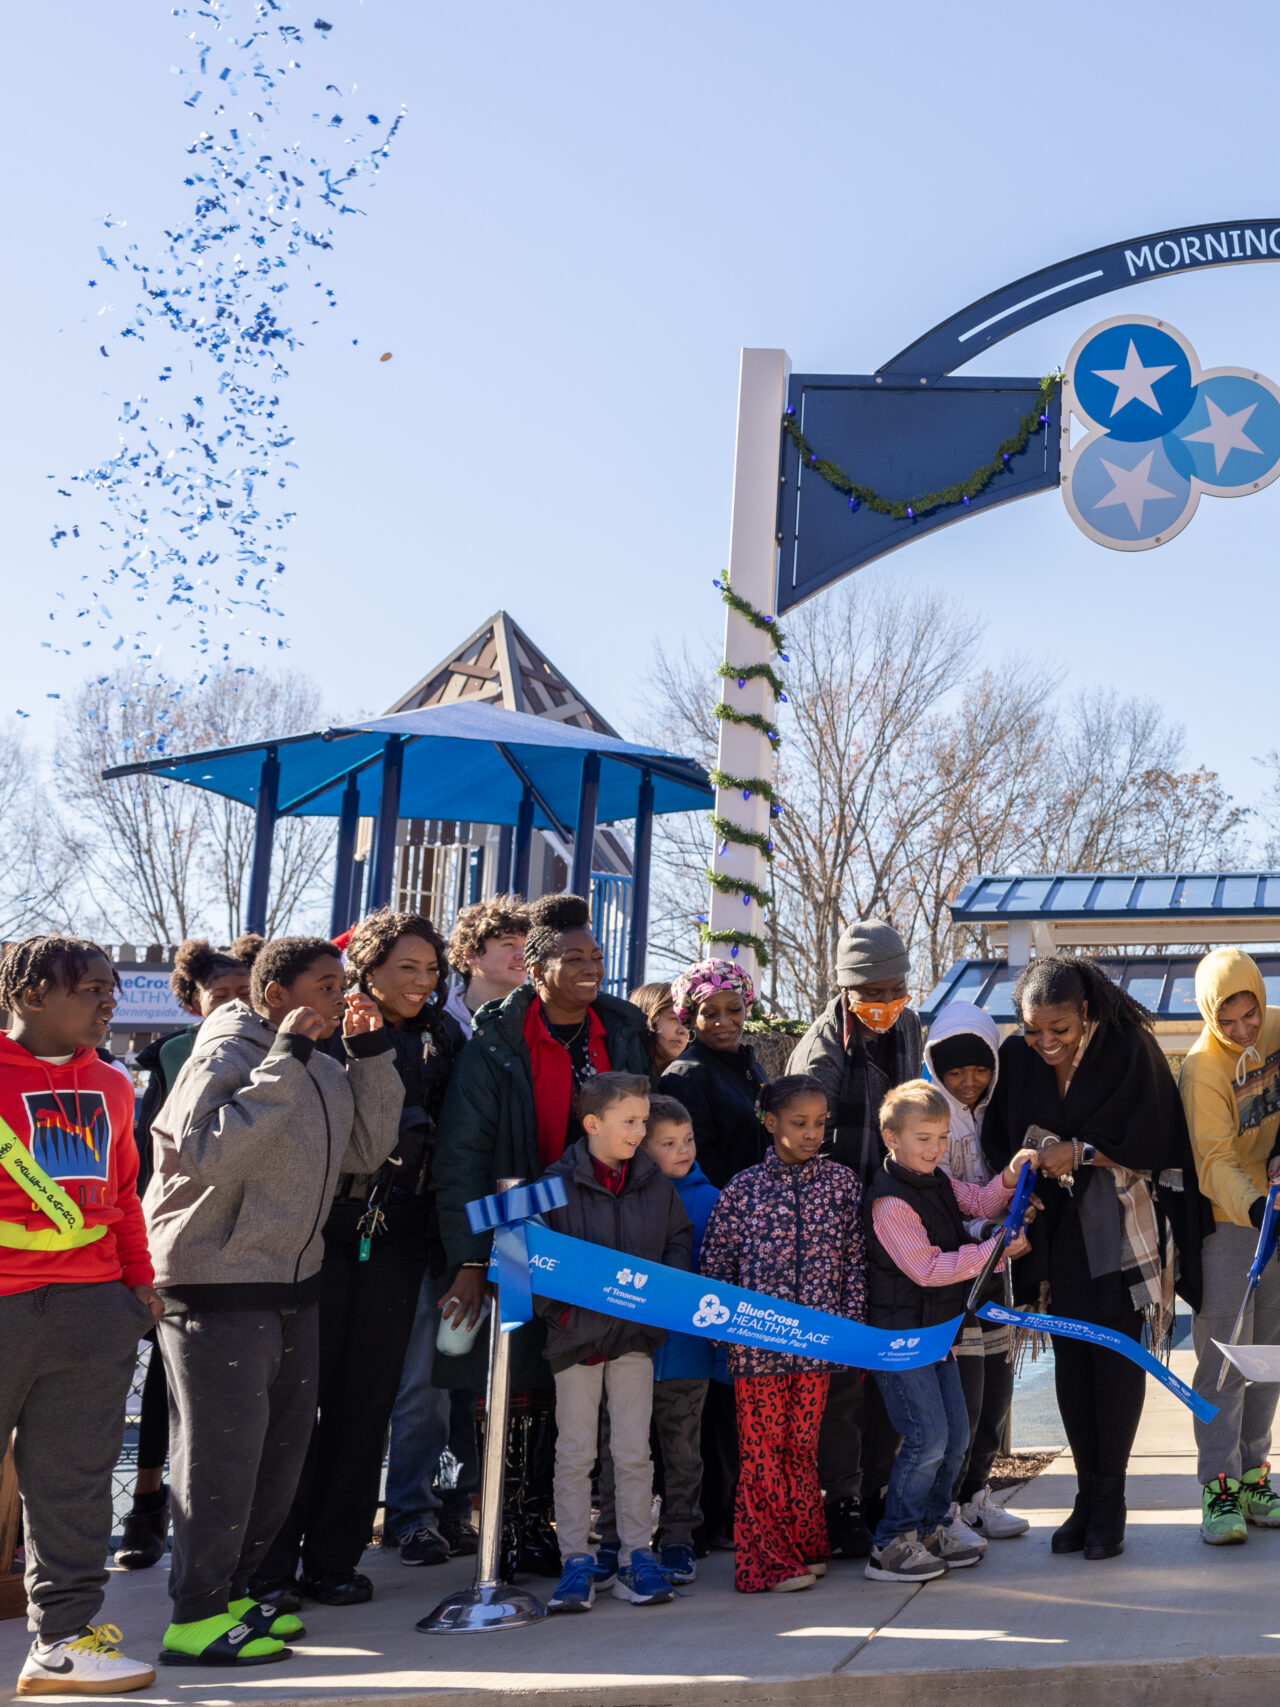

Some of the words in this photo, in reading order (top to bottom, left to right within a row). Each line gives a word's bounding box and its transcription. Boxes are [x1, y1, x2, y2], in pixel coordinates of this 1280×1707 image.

[118, 989, 173, 1004] ALTHY
[14, 1158, 48, 1194] SAFETY
[46, 1193, 76, 1230] PATRO
[528, 1254, 556, 1271] ACE
[603, 1286, 613, 1294] of
[736, 1301, 800, 1328] BlueCross
[726, 1326, 736, 1334] at
[736, 1327, 788, 1343] Morningside
[788, 1339, 808, 1349] Park
[731, 1313, 790, 1336] HEALTHY
[789, 1328, 831, 1345] PLACE
